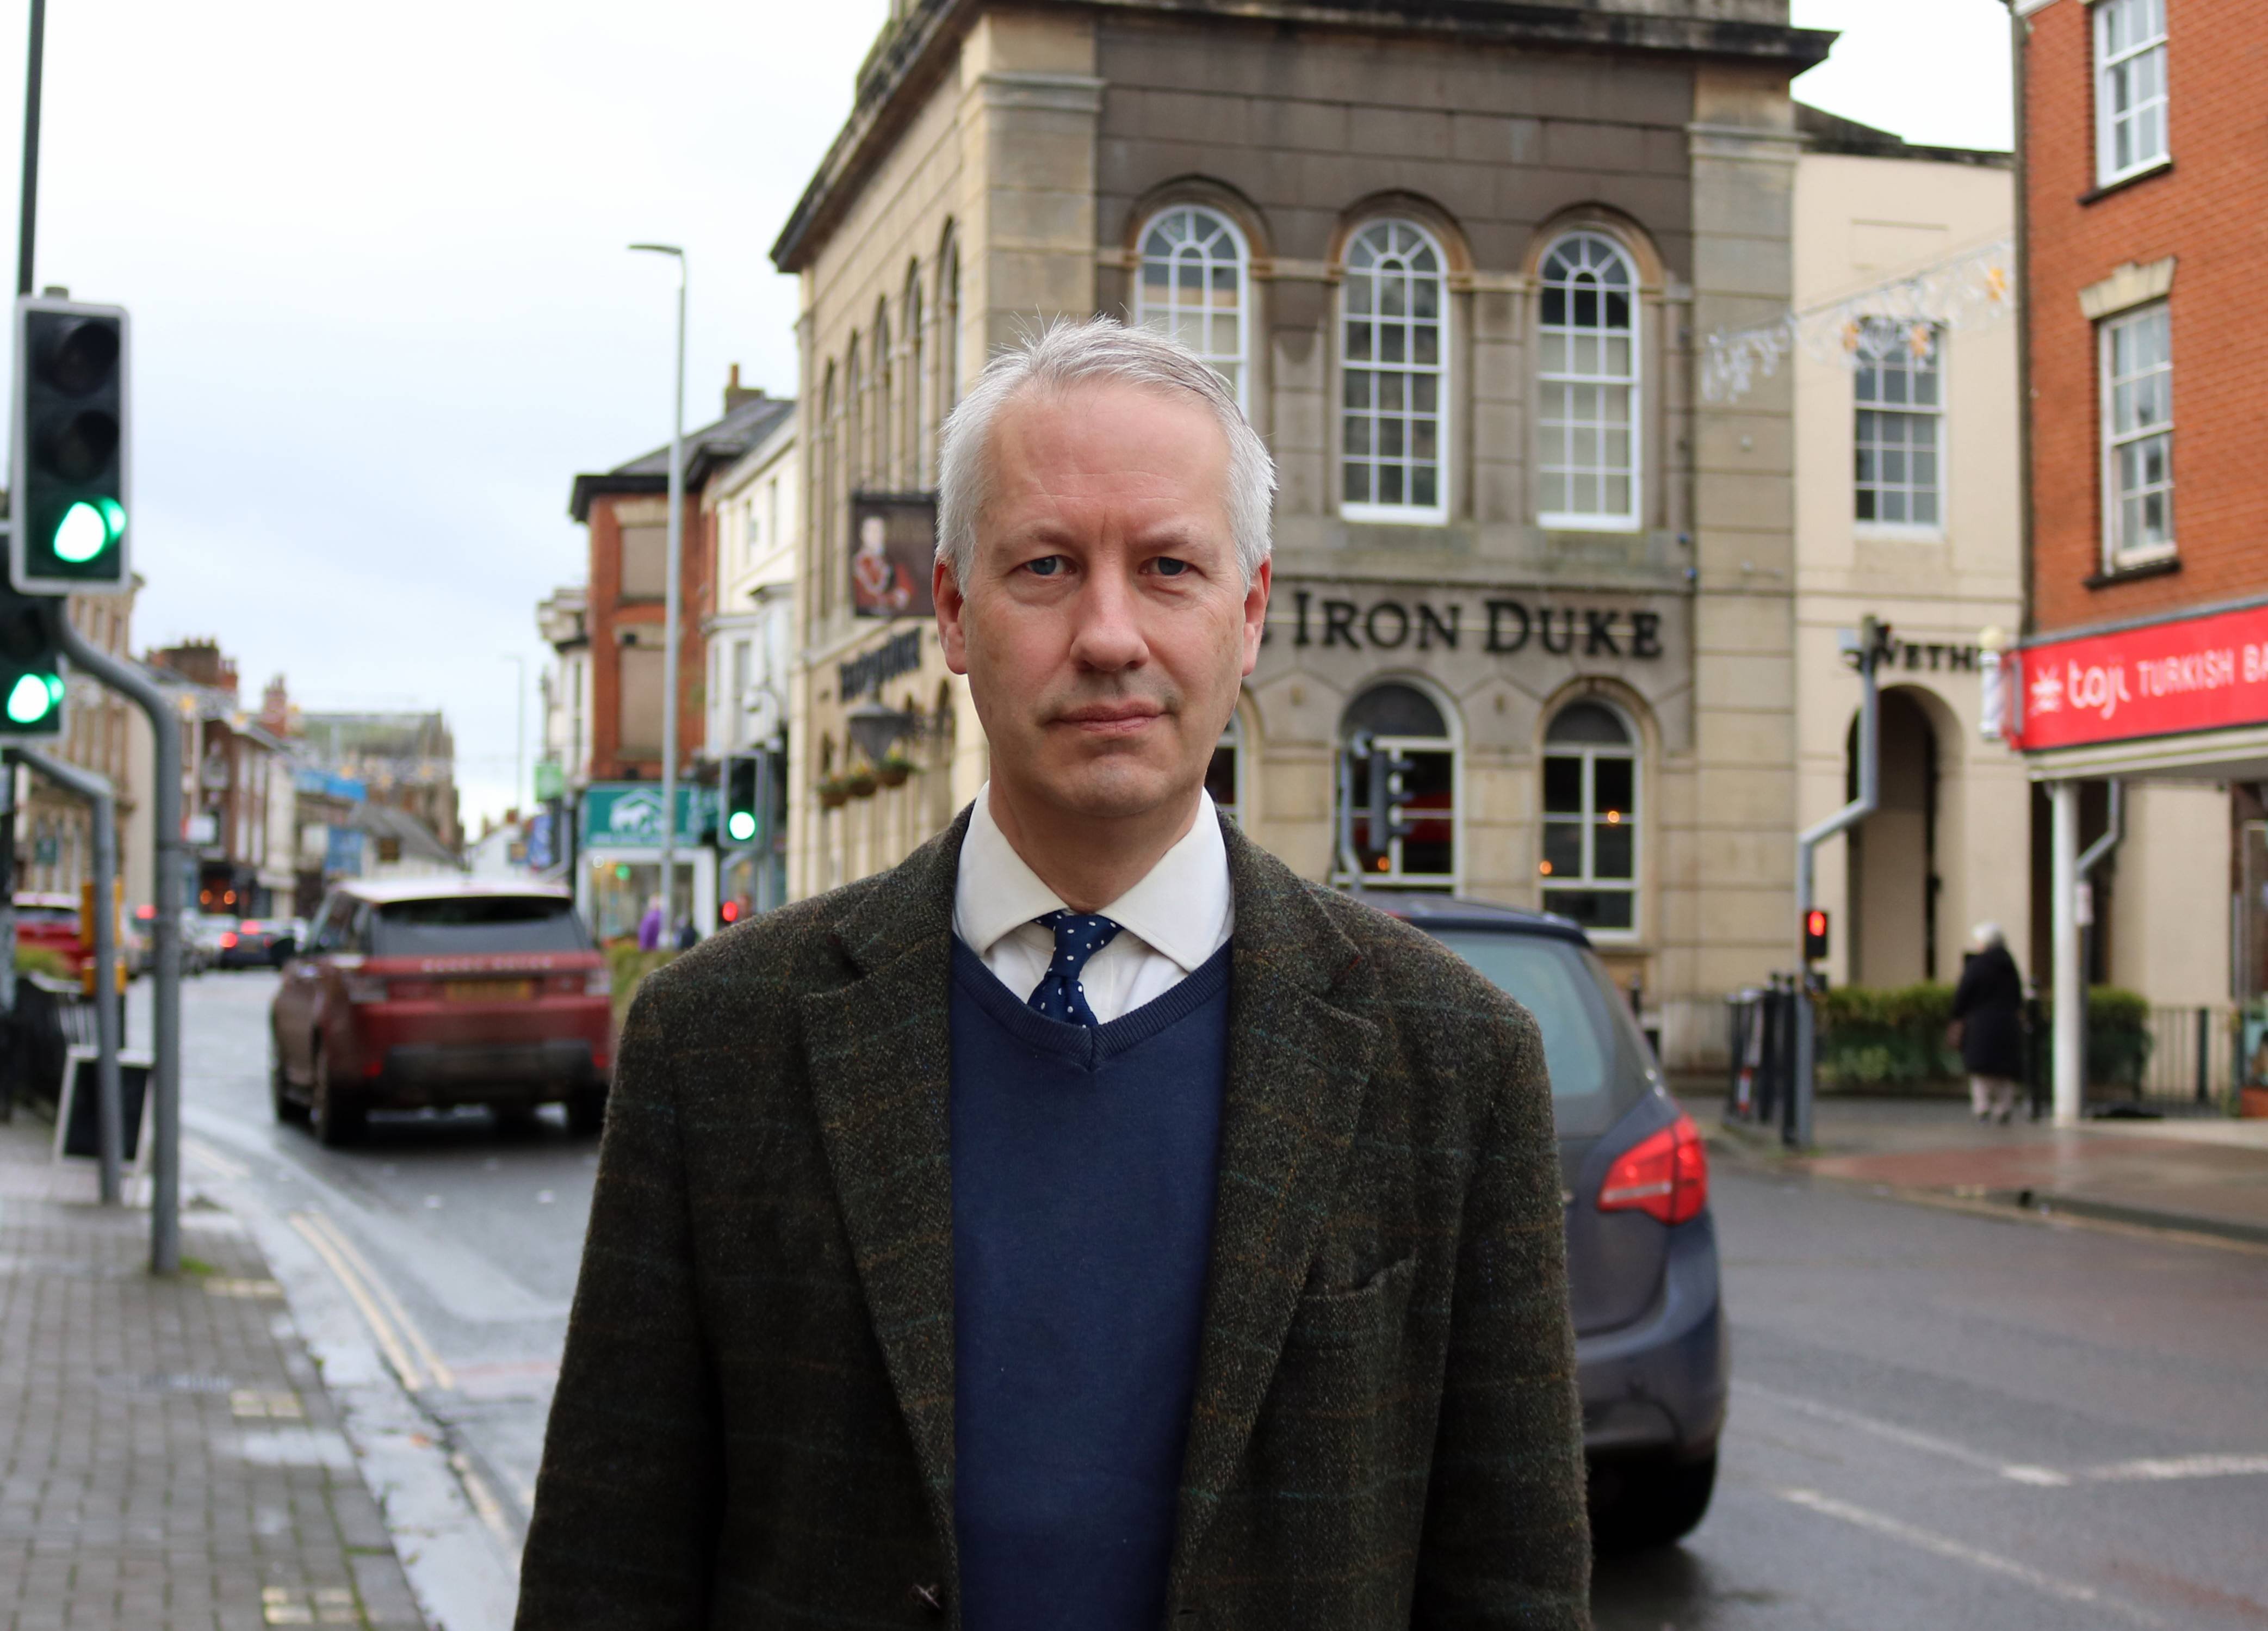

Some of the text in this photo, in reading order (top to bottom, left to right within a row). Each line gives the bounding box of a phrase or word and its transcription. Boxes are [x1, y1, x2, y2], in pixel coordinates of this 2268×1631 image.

[1294, 590, 1462, 650] IRON
[1484, 599, 1663, 659] DUKE
[1872, 639, 1983, 671] WETH
[2137, 648, 2234, 696] TURKISH
